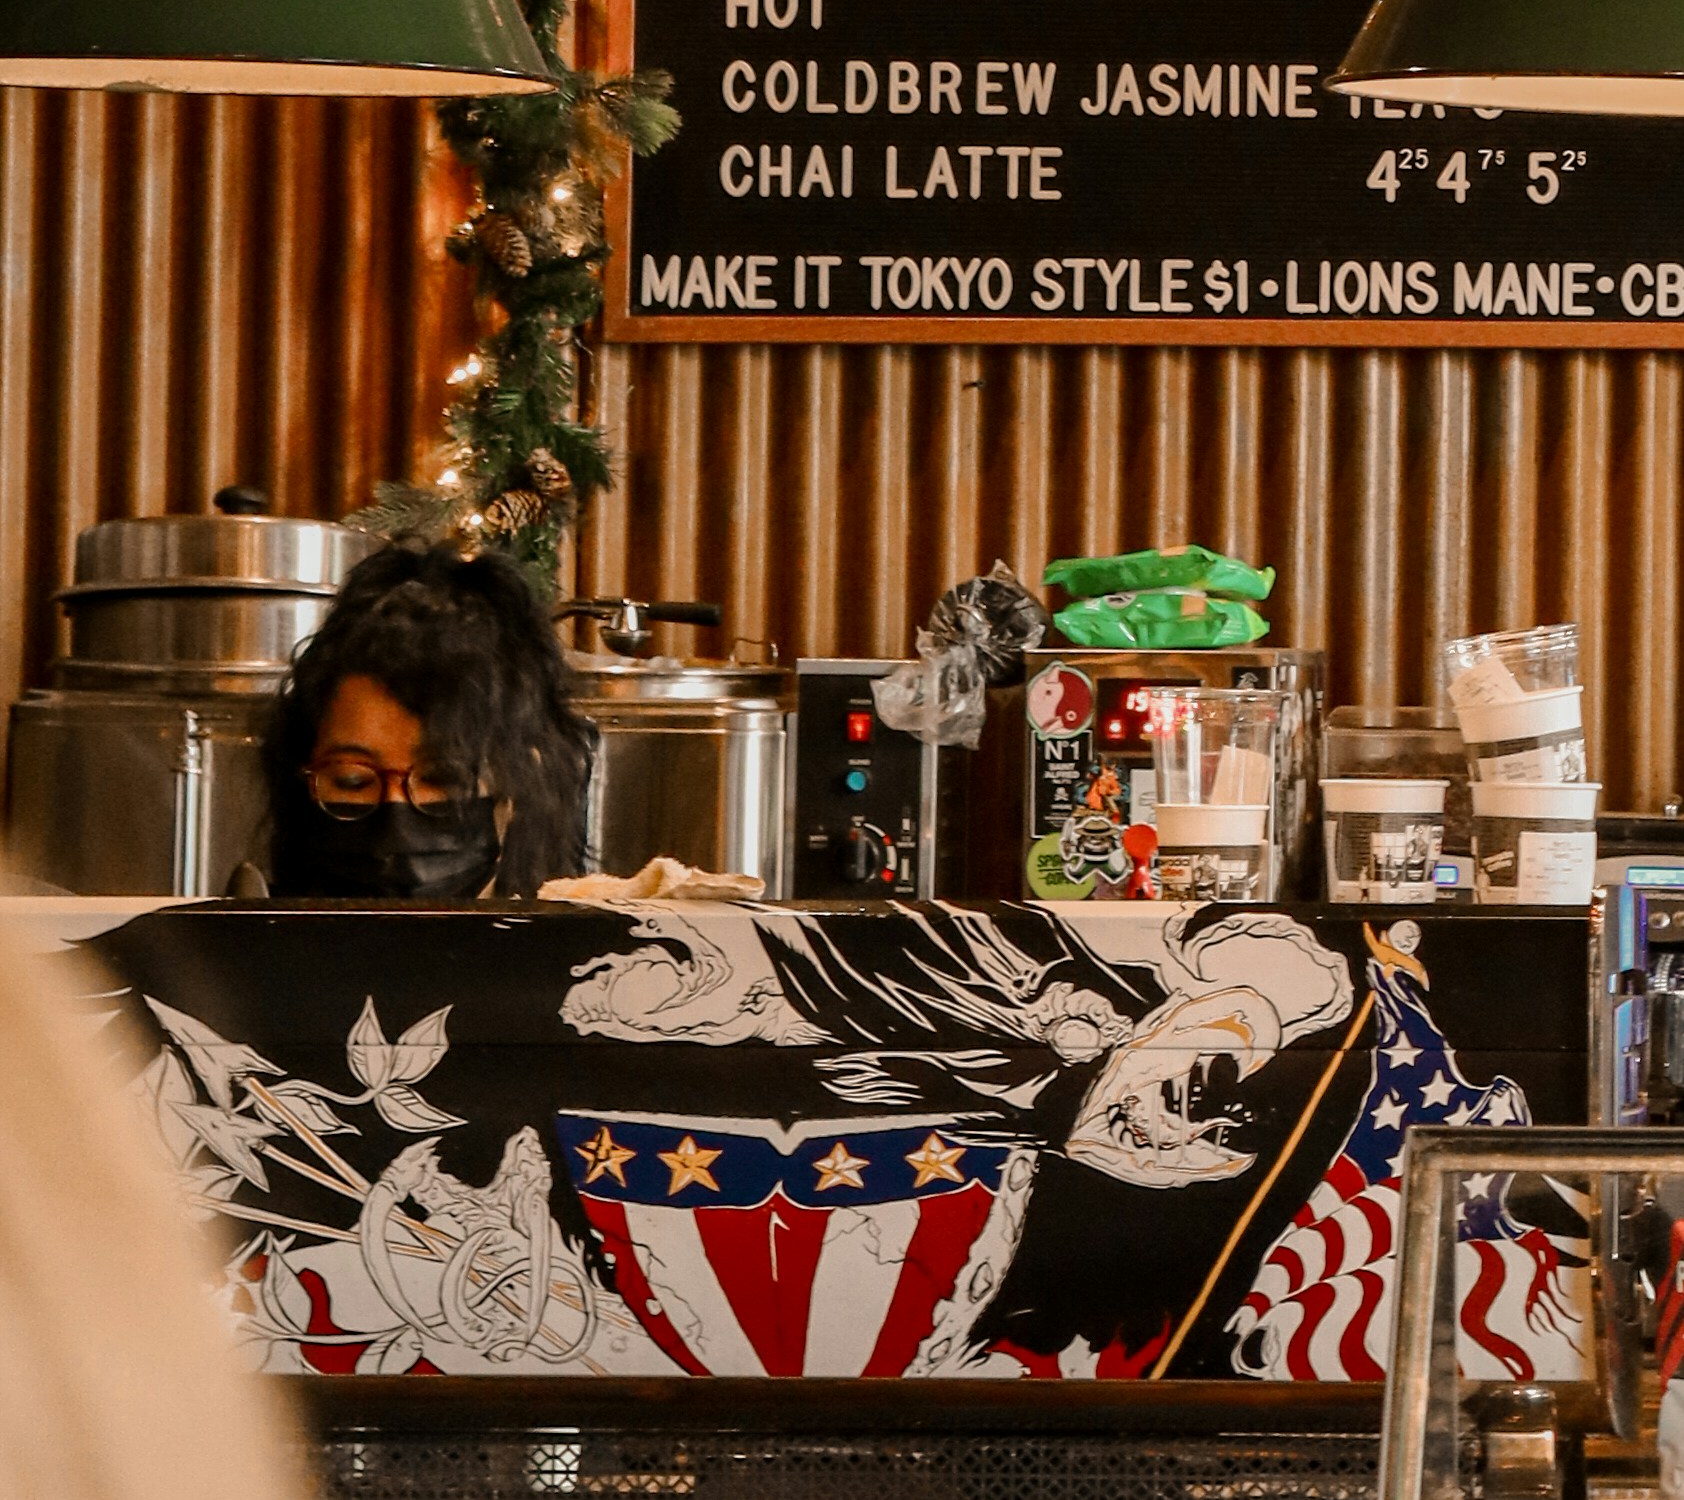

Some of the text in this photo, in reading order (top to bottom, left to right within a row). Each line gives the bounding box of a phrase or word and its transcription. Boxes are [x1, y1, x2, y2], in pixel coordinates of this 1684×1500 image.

[723, 60, 1056, 115] COLDBREW
[1081, 63, 1318, 117] JASMINE
[720, 145, 853, 197] CHAI
[886, 146, 1062, 199] LATTE
[642, 254, 778, 308] MAKE
[795, 256, 842, 308] IT
[859, 257, 1013, 310] TOKYO
[1031, 258, 1193, 312] STYLE
[1286, 261, 1438, 314] LIONS
[1454, 261, 1592, 315] MANE
